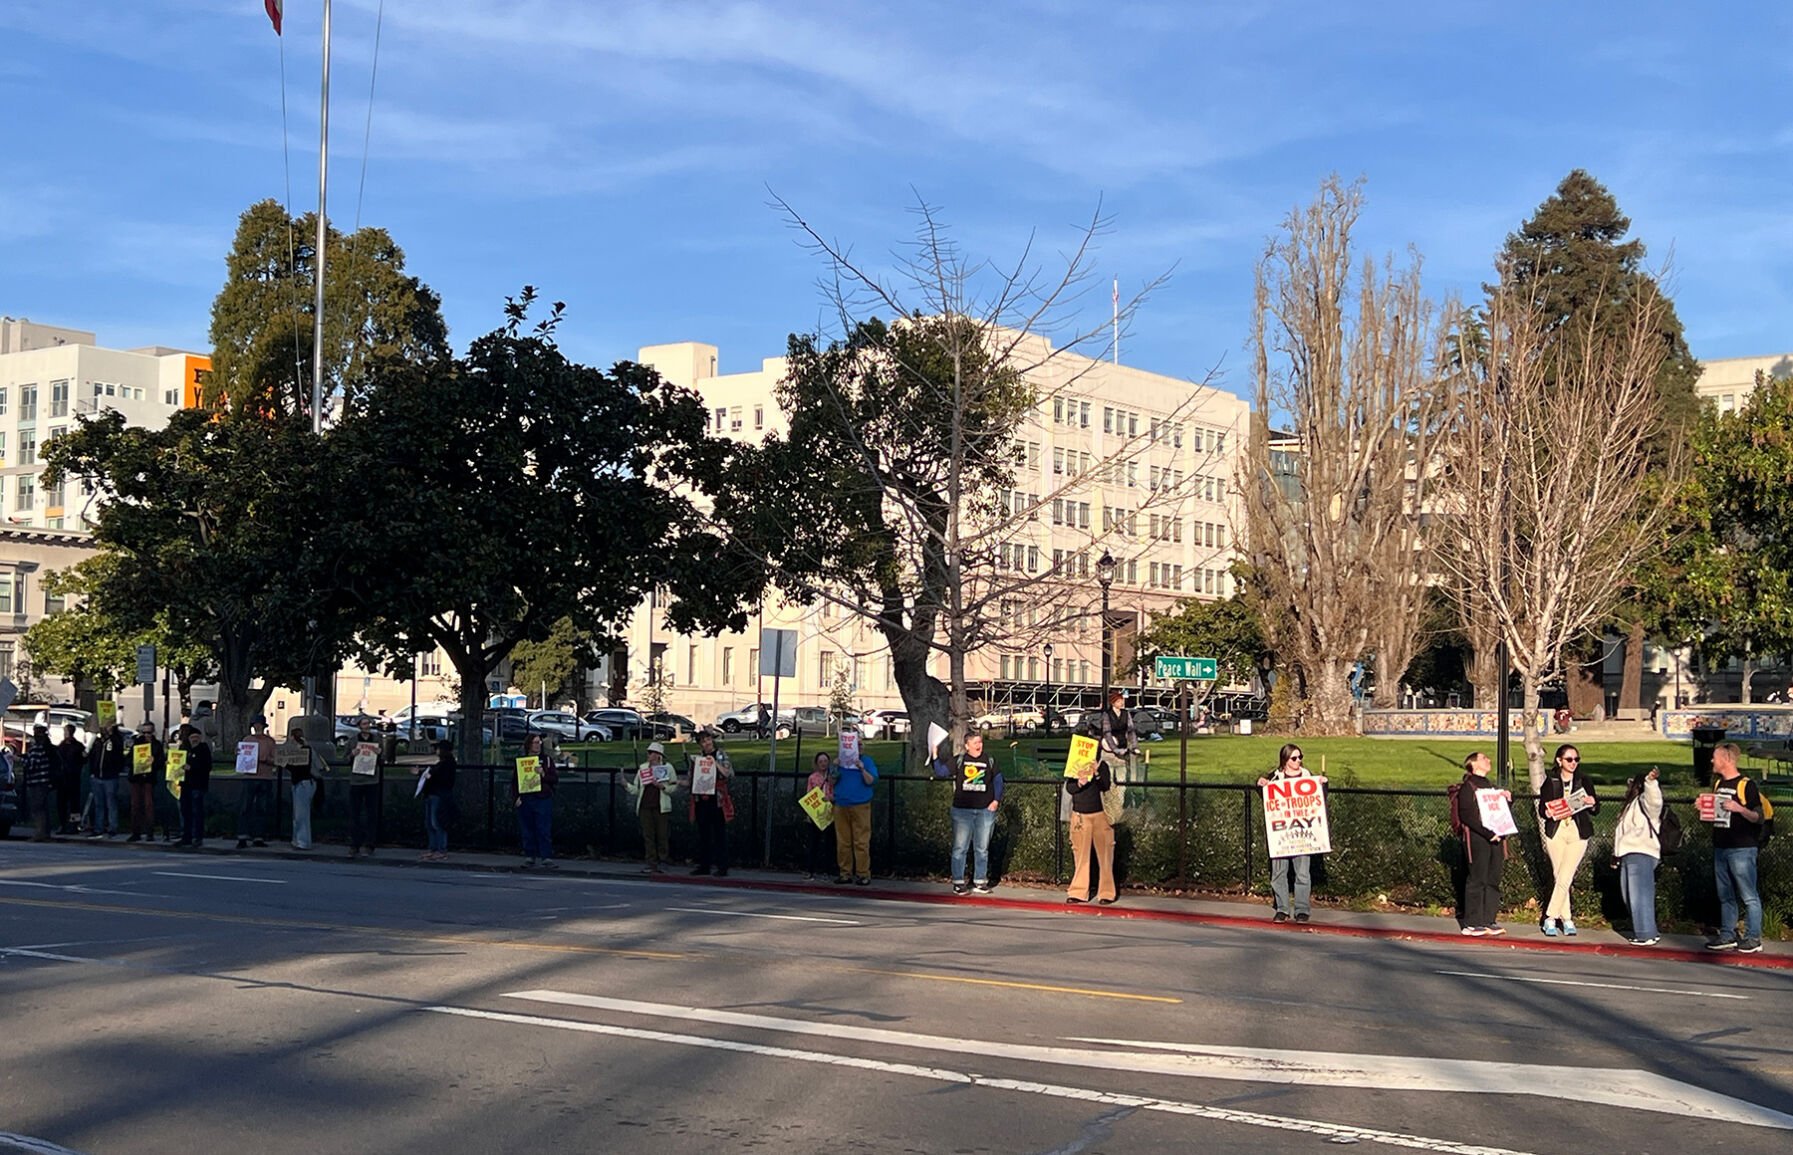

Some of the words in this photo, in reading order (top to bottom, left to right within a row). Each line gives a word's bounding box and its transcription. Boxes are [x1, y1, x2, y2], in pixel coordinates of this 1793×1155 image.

[1158, 660, 1181, 676] Peace
[1185, 661, 1201, 677] Wall
[1076, 740, 1094, 749] STOP
[521, 759, 535, 767] STOP
[1267, 778, 1317, 800] NO
[804, 791, 818, 806] STOP
[811, 799, 822, 810] ICE
[1266, 800, 1280, 812] ICE
[1285, 795, 1321, 809] TROOPS
[1272, 816, 1321, 832] BAY!
